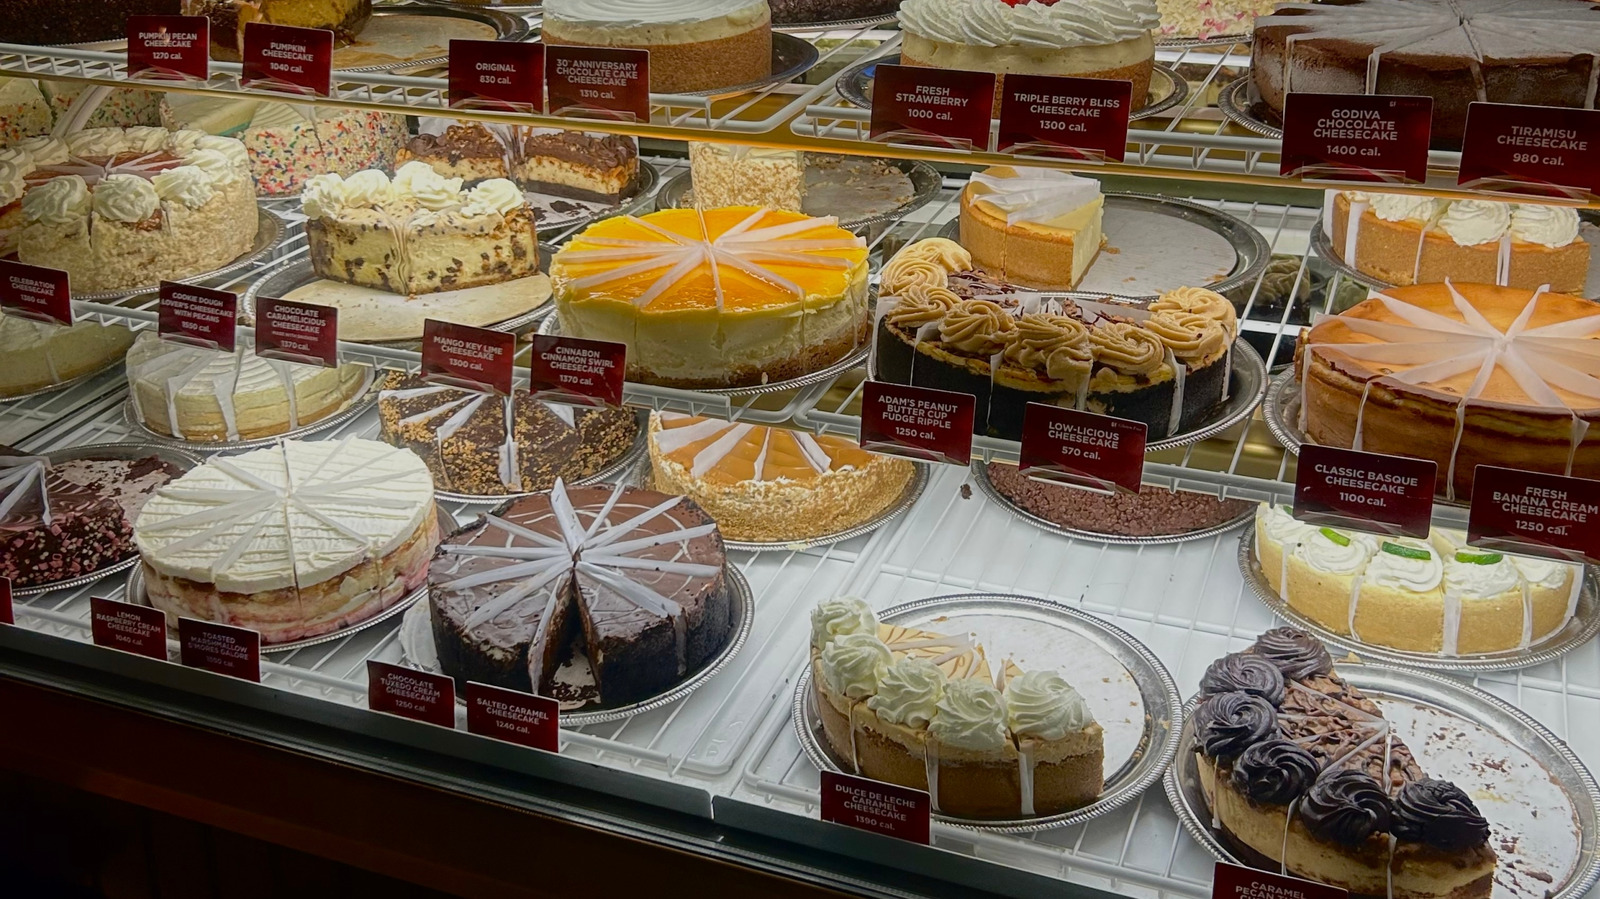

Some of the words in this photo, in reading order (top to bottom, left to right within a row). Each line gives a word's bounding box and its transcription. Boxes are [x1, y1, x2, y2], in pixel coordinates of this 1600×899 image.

[270, 42, 306, 52] PUMPKIN
[262, 49, 313, 61] CHEESECAKE
[270, 63, 289, 71] 1040
[476, 63, 516, 72] ORIGINAL
[574, 60, 637, 71] ANNIVERSARY
[480, 76, 496, 84] 830
[556, 67, 611, 77] CHOCOLATE
[613, 71, 638, 79] CAKE
[568, 76, 626, 86] CHEESECAKE
[580, 89, 599, 98] 1310
[600, 90, 615, 99] cal.
[916, 85, 949, 96] FRESH
[896, 93, 968, 107] STRAWBERRY
[1014, 93, 1049, 104] TRIPLE
[1052, 95, 1087, 106] BERRY
[1090, 98, 1120, 108] BLISS
[908, 109, 933, 118] 1000
[936, 112, 952, 120] cal.
[1030, 105, 1100, 117] CHEESECAKE
[1332, 109, 1380, 119] GODIVA
[1040, 121, 1065, 130] 1300
[1069, 123, 1087, 132] cal.
[1318, 119, 1395, 130] CHOCOLATE
[1314, 128, 1398, 140] CHEESECAKE
[1512, 126, 1576, 139] TIRAMISU
[1497, 135, 1587, 150] CHEESECAKE
[1327, 145, 1356, 155] 1400
[1360, 147, 1380, 156] cal.
[1513, 153, 1539, 163] 980
[1543, 157, 1564, 166] cal.
[10, 276, 55, 289] CELEBRATION
[12, 282, 54, 296] CHEESECAKE
[172, 292, 198, 302] COOKIE
[199, 297, 223, 307] DOUGH
[162, 299, 189, 309] LOVER'S
[190, 304, 233, 317] CHEESECAKE
[274, 305, 319, 317] CHOCOLATE
[174, 309, 192, 317] WITH
[193, 312, 219, 323] PECANS
[266, 312, 326, 326] CARAMELICIOUS
[272, 321, 320, 333] CHEESECAKE
[281, 340, 297, 349] 1370
[433, 336, 464, 347] MANGO
[466, 342, 482, 350] KEY
[484, 345, 503, 355] LIME
[441, 345, 494, 361] CHEESECAKE
[556, 346, 600, 358] CINNABON
[449, 358, 468, 368] 1300
[470, 363, 483, 371] cal.
[541, 353, 586, 364] CINNAMON
[588, 359, 615, 368] SWIRL
[550, 361, 604, 374] CHEESECAKE
[560, 374, 578, 383] 1370
[878, 395, 915, 407] ADAM'S
[918, 401, 958, 413] PEANUT
[887, 405, 925, 417] BUTTER
[928, 411, 947, 419] CUP
[883, 412, 915, 423] FUDGE
[917, 417, 951, 429] RIPPLE
[896, 427, 917, 437] 1250
[920, 432, 935, 440] cal.
[1049, 421, 1119, 440] LOW-LICIOUS
[1048, 430, 1119, 449] CHEESECAKE
[1062, 446, 1080, 456] 570
[1084, 451, 1100, 460] cal.
[1315, 464, 1365, 479] CLASSIC
[1368, 472, 1418, 486] BASQUE
[1325, 476, 1405, 495] CHEESECAKE
[1340, 492, 1365, 503] 1100
[1367, 497, 1386, 507] cal.
[1526, 486, 1567, 500] FRESH
[1493, 491, 1548, 507] BANANA
[1552, 500, 1598, 514] CREAM
[1502, 503, 1587, 523] CHEESECAKE
[1516, 520, 1544, 532] 1250
[1547, 526, 1568, 536] cal.
[96, 613, 136, 627] RASPBERRY
[138, 622, 161, 633] CREAM
[117, 611, 141, 621] LEMON
[108, 622, 150, 637] CHEESECAKE
[191, 636, 248, 653] MARSHMALLOW
[202, 632, 235, 644] TOASTED
[221, 649, 248, 660] GALORE
[381, 678, 411, 690] TUXEDO
[413, 686, 440, 698] CREAM
[388, 673, 433, 689] CHOCOLATE
[386, 687, 436, 703] CHEESECAKE
[396, 700, 412, 709] 1250
[477, 698, 507, 710] SALTED
[509, 705, 549, 720] CARAMEL
[486, 707, 539, 725] CHEESECAKE
[496, 721, 514, 730] 1240
[516, 726, 530, 734] cal.
[836, 784, 866, 797] DULCE
[869, 792, 882, 800] DE
[885, 795, 915, 808] LECHE
[844, 801, 907, 821] CHEESECAKE
[852, 796, 898, 812] CARAMEL
[856, 815, 877, 826] 1390
[879, 821, 895, 830] cal.
[1236, 885, 1274, 899] PECAN
[1251, 881, 1307, 899] CARAMEL
